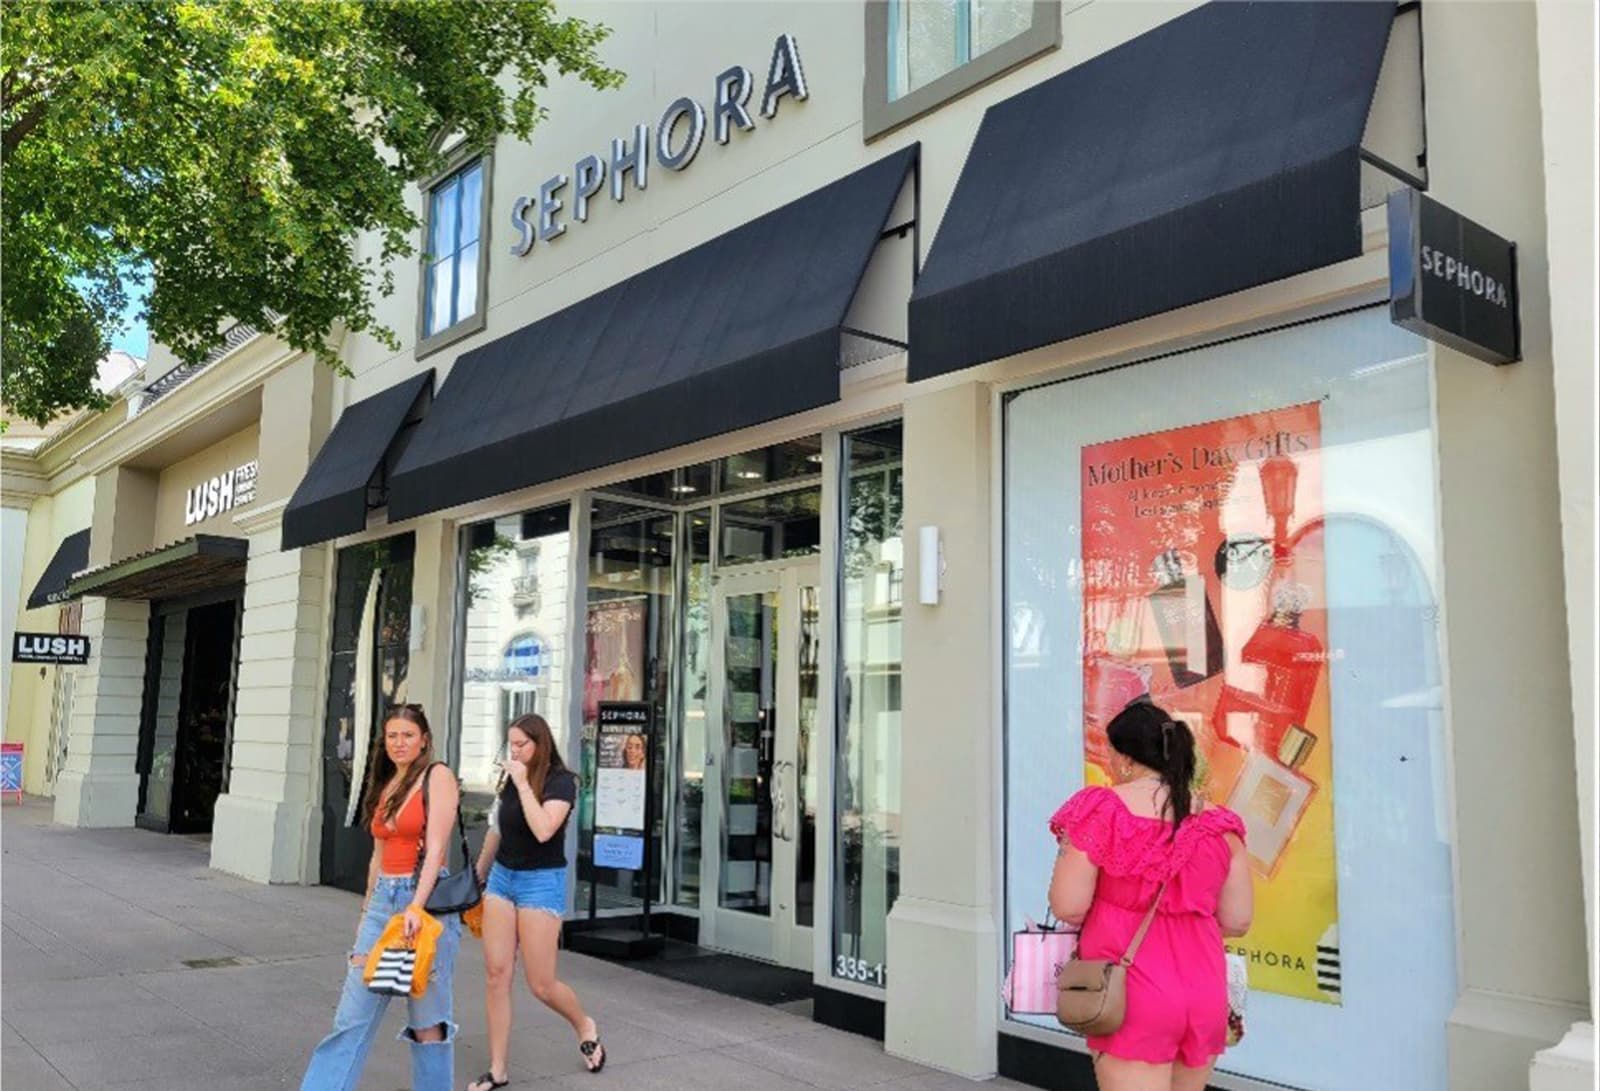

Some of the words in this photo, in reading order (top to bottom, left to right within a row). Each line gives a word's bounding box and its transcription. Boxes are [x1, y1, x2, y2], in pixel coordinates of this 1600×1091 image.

[509, 33, 809, 257] SEPHORA
[1421, 244, 1508, 309] SEPHORA
[1087, 451, 1184, 488] Mother's
[1192, 446, 1238, 471] Day
[1244, 431, 1310, 460] Gifts
[185, 470, 236, 526] LUSH
[18, 636, 85, 656] LUSH
[601, 710, 647, 721] SEPHORA
